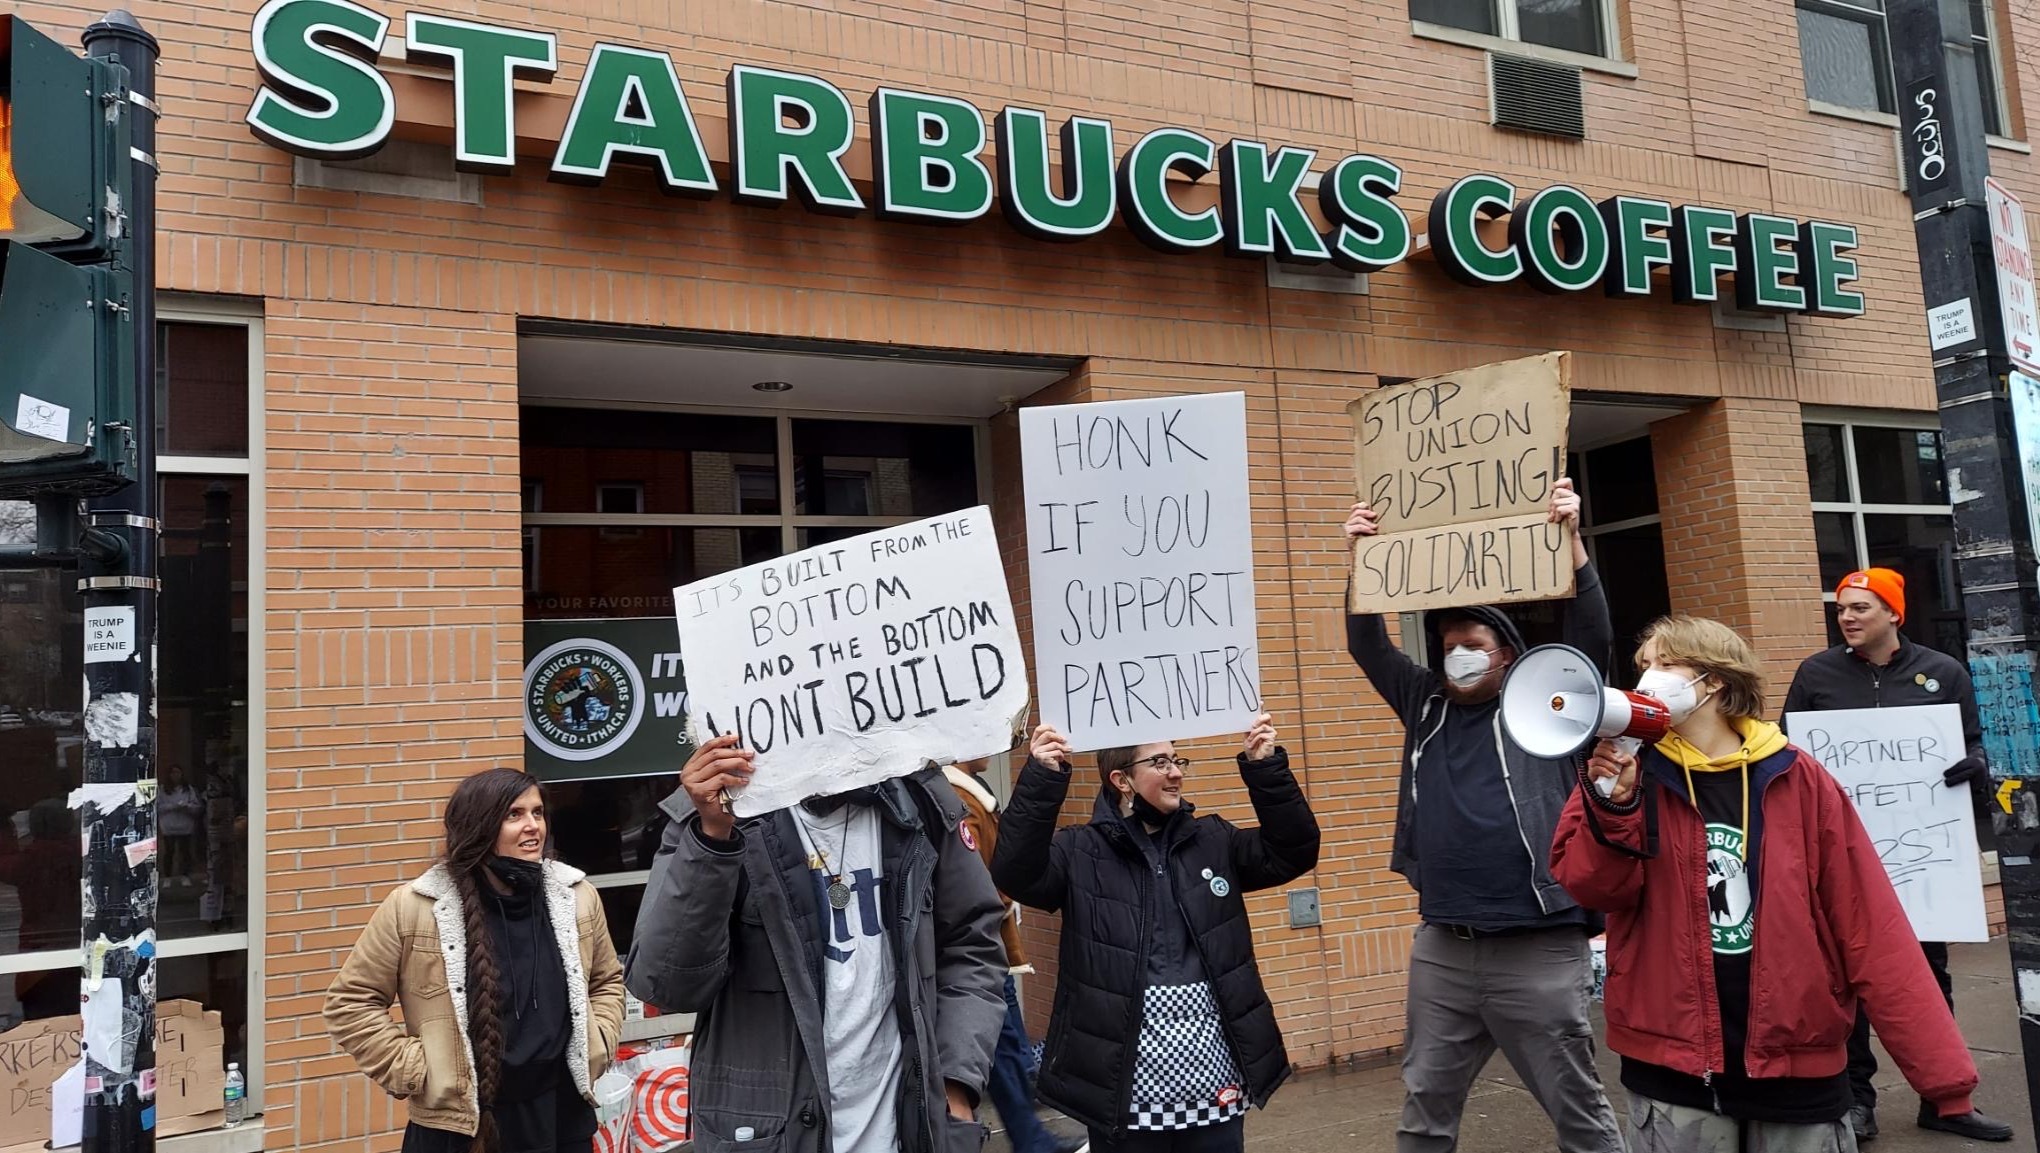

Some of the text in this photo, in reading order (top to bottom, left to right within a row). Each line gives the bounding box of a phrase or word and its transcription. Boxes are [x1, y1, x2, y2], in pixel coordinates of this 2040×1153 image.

[245, 0, 1866, 317] STARBUCKS COFFEE
[1999, 203, 2014, 237] NO
[1995, 234, 2032, 283] STANDING
[1936, 308, 1965, 322] TRUMP
[2010, 280, 2026, 307] ANY
[1937, 325, 1969, 341] WEENIE
[1943, 319, 1960, 330] IS A
[2010, 307, 2032, 337] TIME
[1364, 381, 1462, 446] STOP
[1407, 401, 1532, 463] UNION
[1053, 408, 1208, 476] HONK
[1039, 489, 1210, 557] IF YOU
[689, 518, 972, 618] ITS BUILT FROM THE
[1360, 522, 1563, 598] SOLIDARITY
[88, 618, 124, 628] TRUMP
[535, 597, 583, 609] YOUR
[749, 575, 911, 647] BOTTOM
[1060, 571, 1245, 647] SUPPORT
[87, 641, 127, 652] WEENIE
[94, 630, 115, 639] IS A
[743, 601, 999, 685] AND THE BOTTOM
[533, 653, 630, 706] STARBUCKS WORKERS
[845, 643, 1006, 733] BUILD
[1064, 646, 1260, 734] PARTNERS
[537, 711, 627, 745] UNITED ITHACA
[1806, 728, 1948, 769] PARTNER
